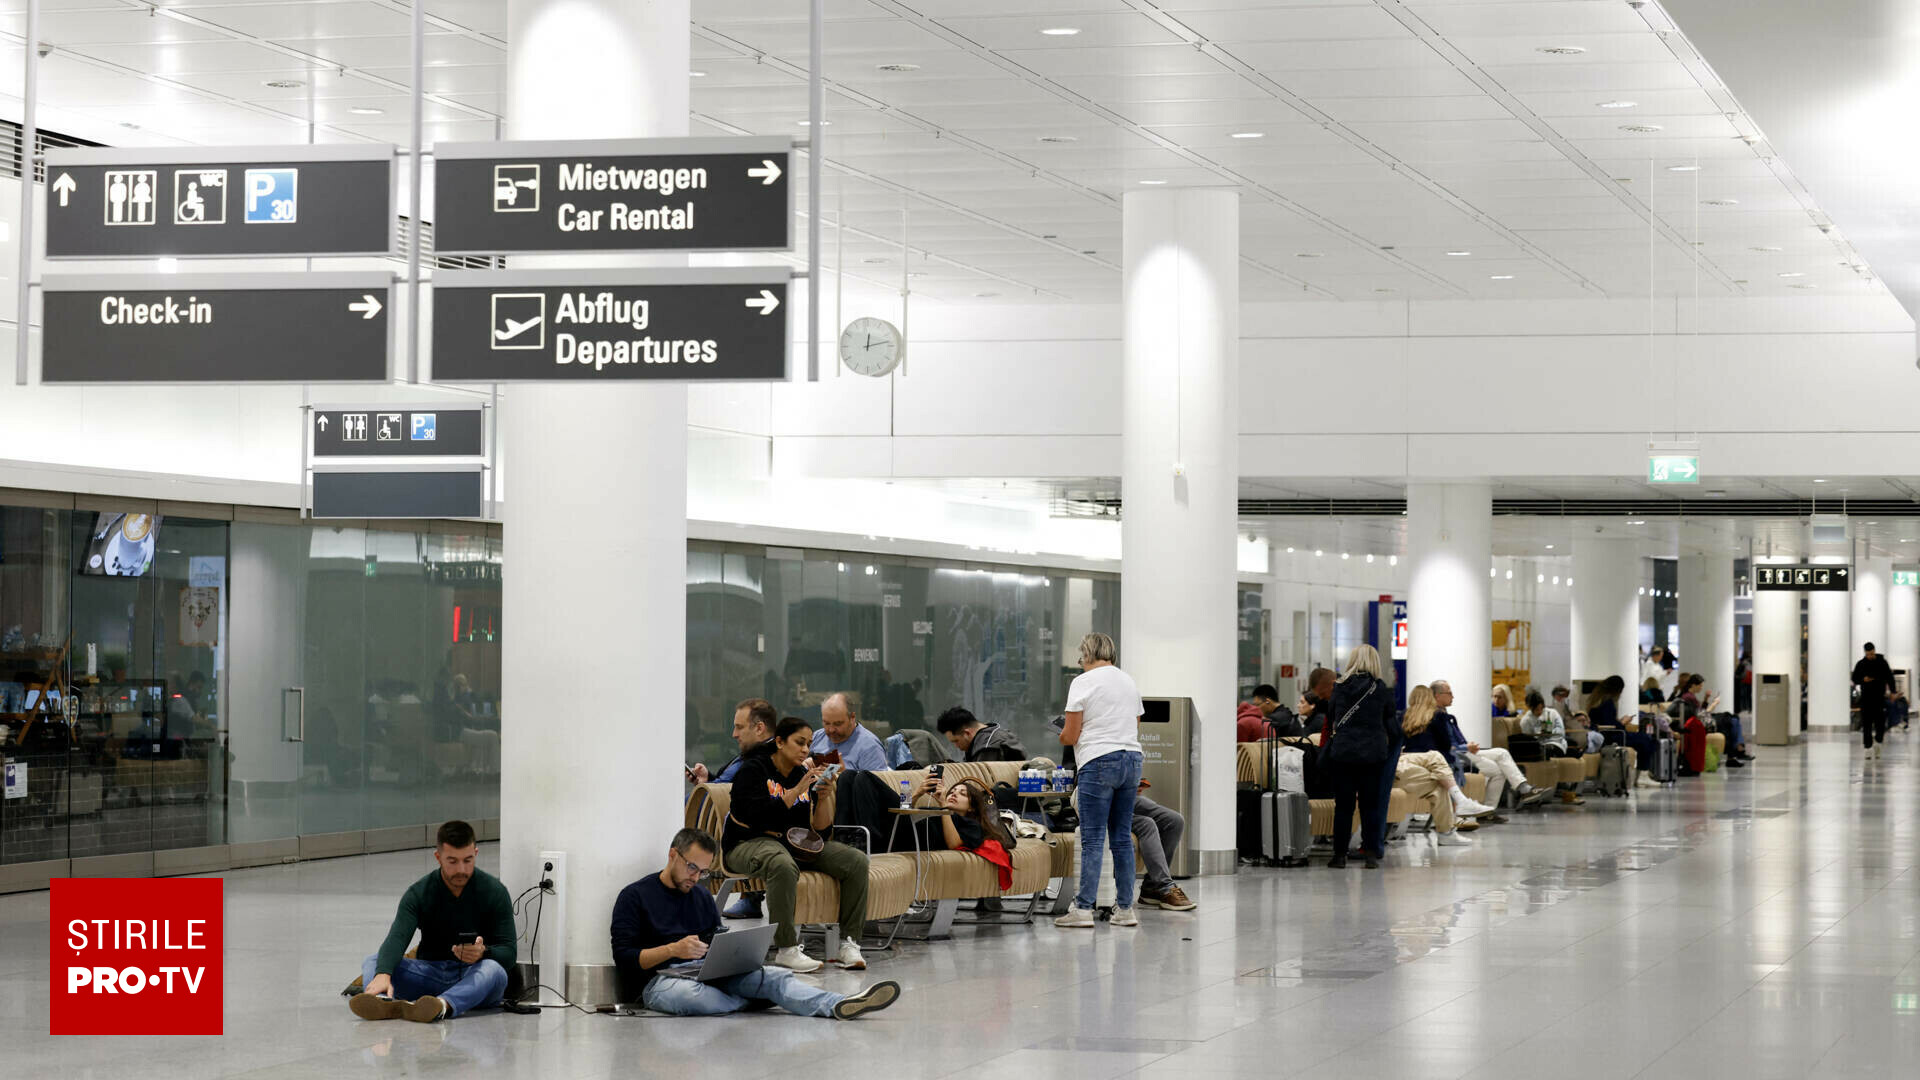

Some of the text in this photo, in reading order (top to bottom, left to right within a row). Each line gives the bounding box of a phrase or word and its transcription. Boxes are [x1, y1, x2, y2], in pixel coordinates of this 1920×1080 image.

[199, 173, 223, 187] WC
[248, 173, 276, 212] P
[558, 163, 707, 196] Mietwagen
[270, 199, 294, 220] 30
[558, 202, 694, 231] Car Rental
[100, 296, 212, 325] Check-in
[555, 292, 649, 331] Abflug
[556, 334, 718, 371] Departures
[389, 415, 400, 423] WC
[412, 416, 425, 435] P
[424, 428, 434, 439] 30
